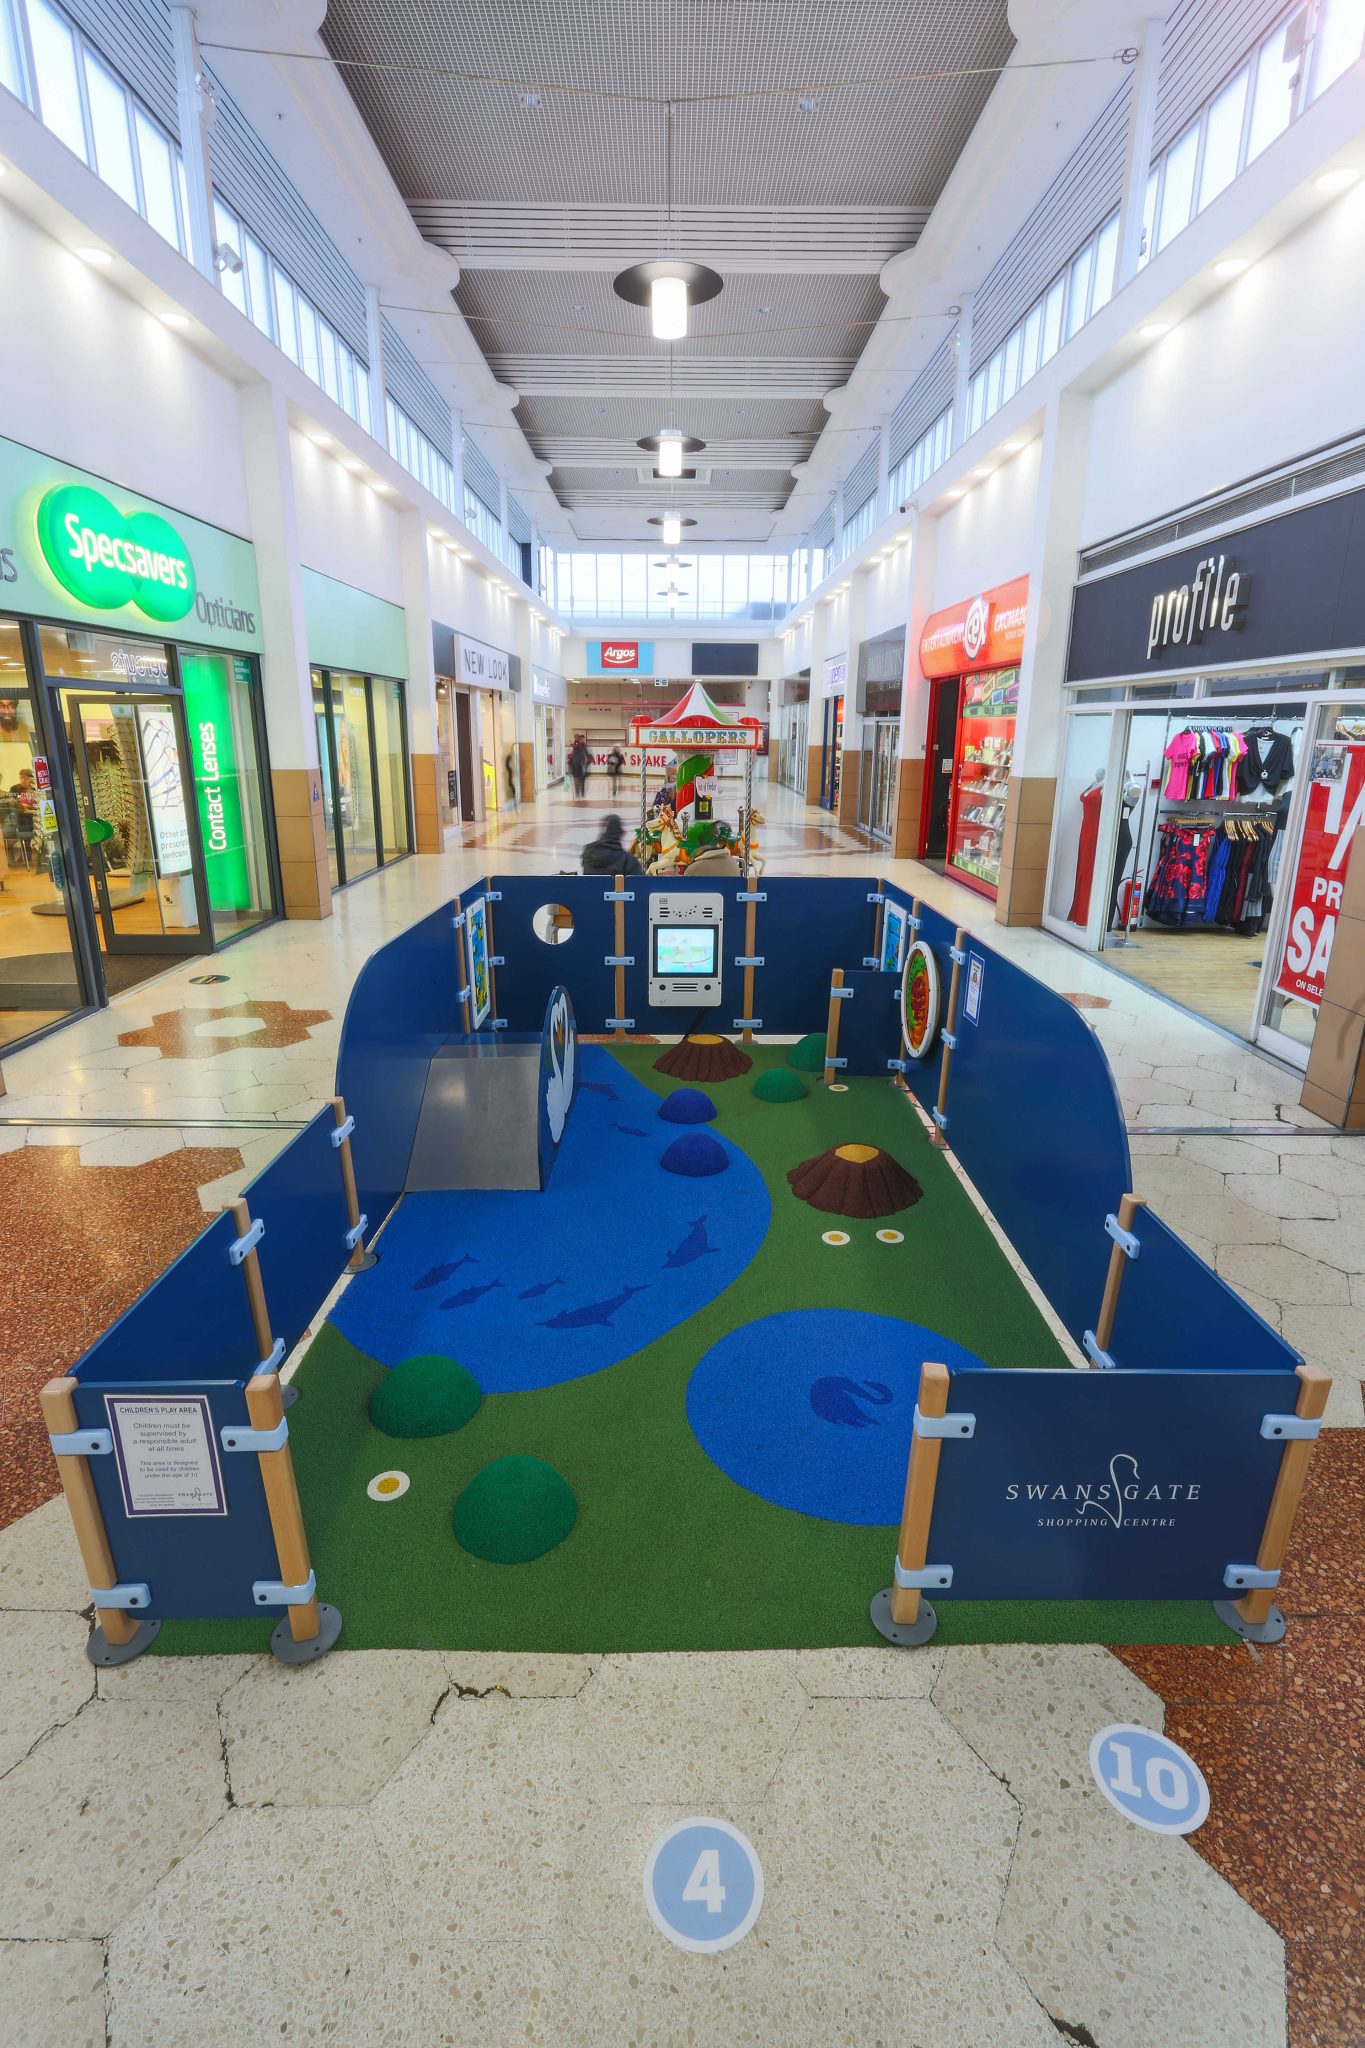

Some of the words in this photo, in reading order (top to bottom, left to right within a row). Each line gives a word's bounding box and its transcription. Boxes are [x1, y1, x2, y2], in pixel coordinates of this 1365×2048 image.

[65, 513, 188, 589] Specsavers
[195, 591, 256, 635] Opticians
[1146, 554, 1241, 660] profile
[464, 648, 484, 678] NEW
[488, 657, 508, 683] LOOK
[604, 646, 636, 661] Argos
[199, 722, 220, 781] Lenses
[648, 730, 747, 744] GALLOPERS
[160, 830, 179, 838] Other
[204, 786, 227, 850] Contact
[1295, 979, 1307, 990] ON
[1037, 1518, 1108, 1527] SHOPPING
[1123, 1518, 1176, 1527] CENTRE
[1109, 1741, 1191, 1811] 10
[682, 1849, 726, 1913] 4
